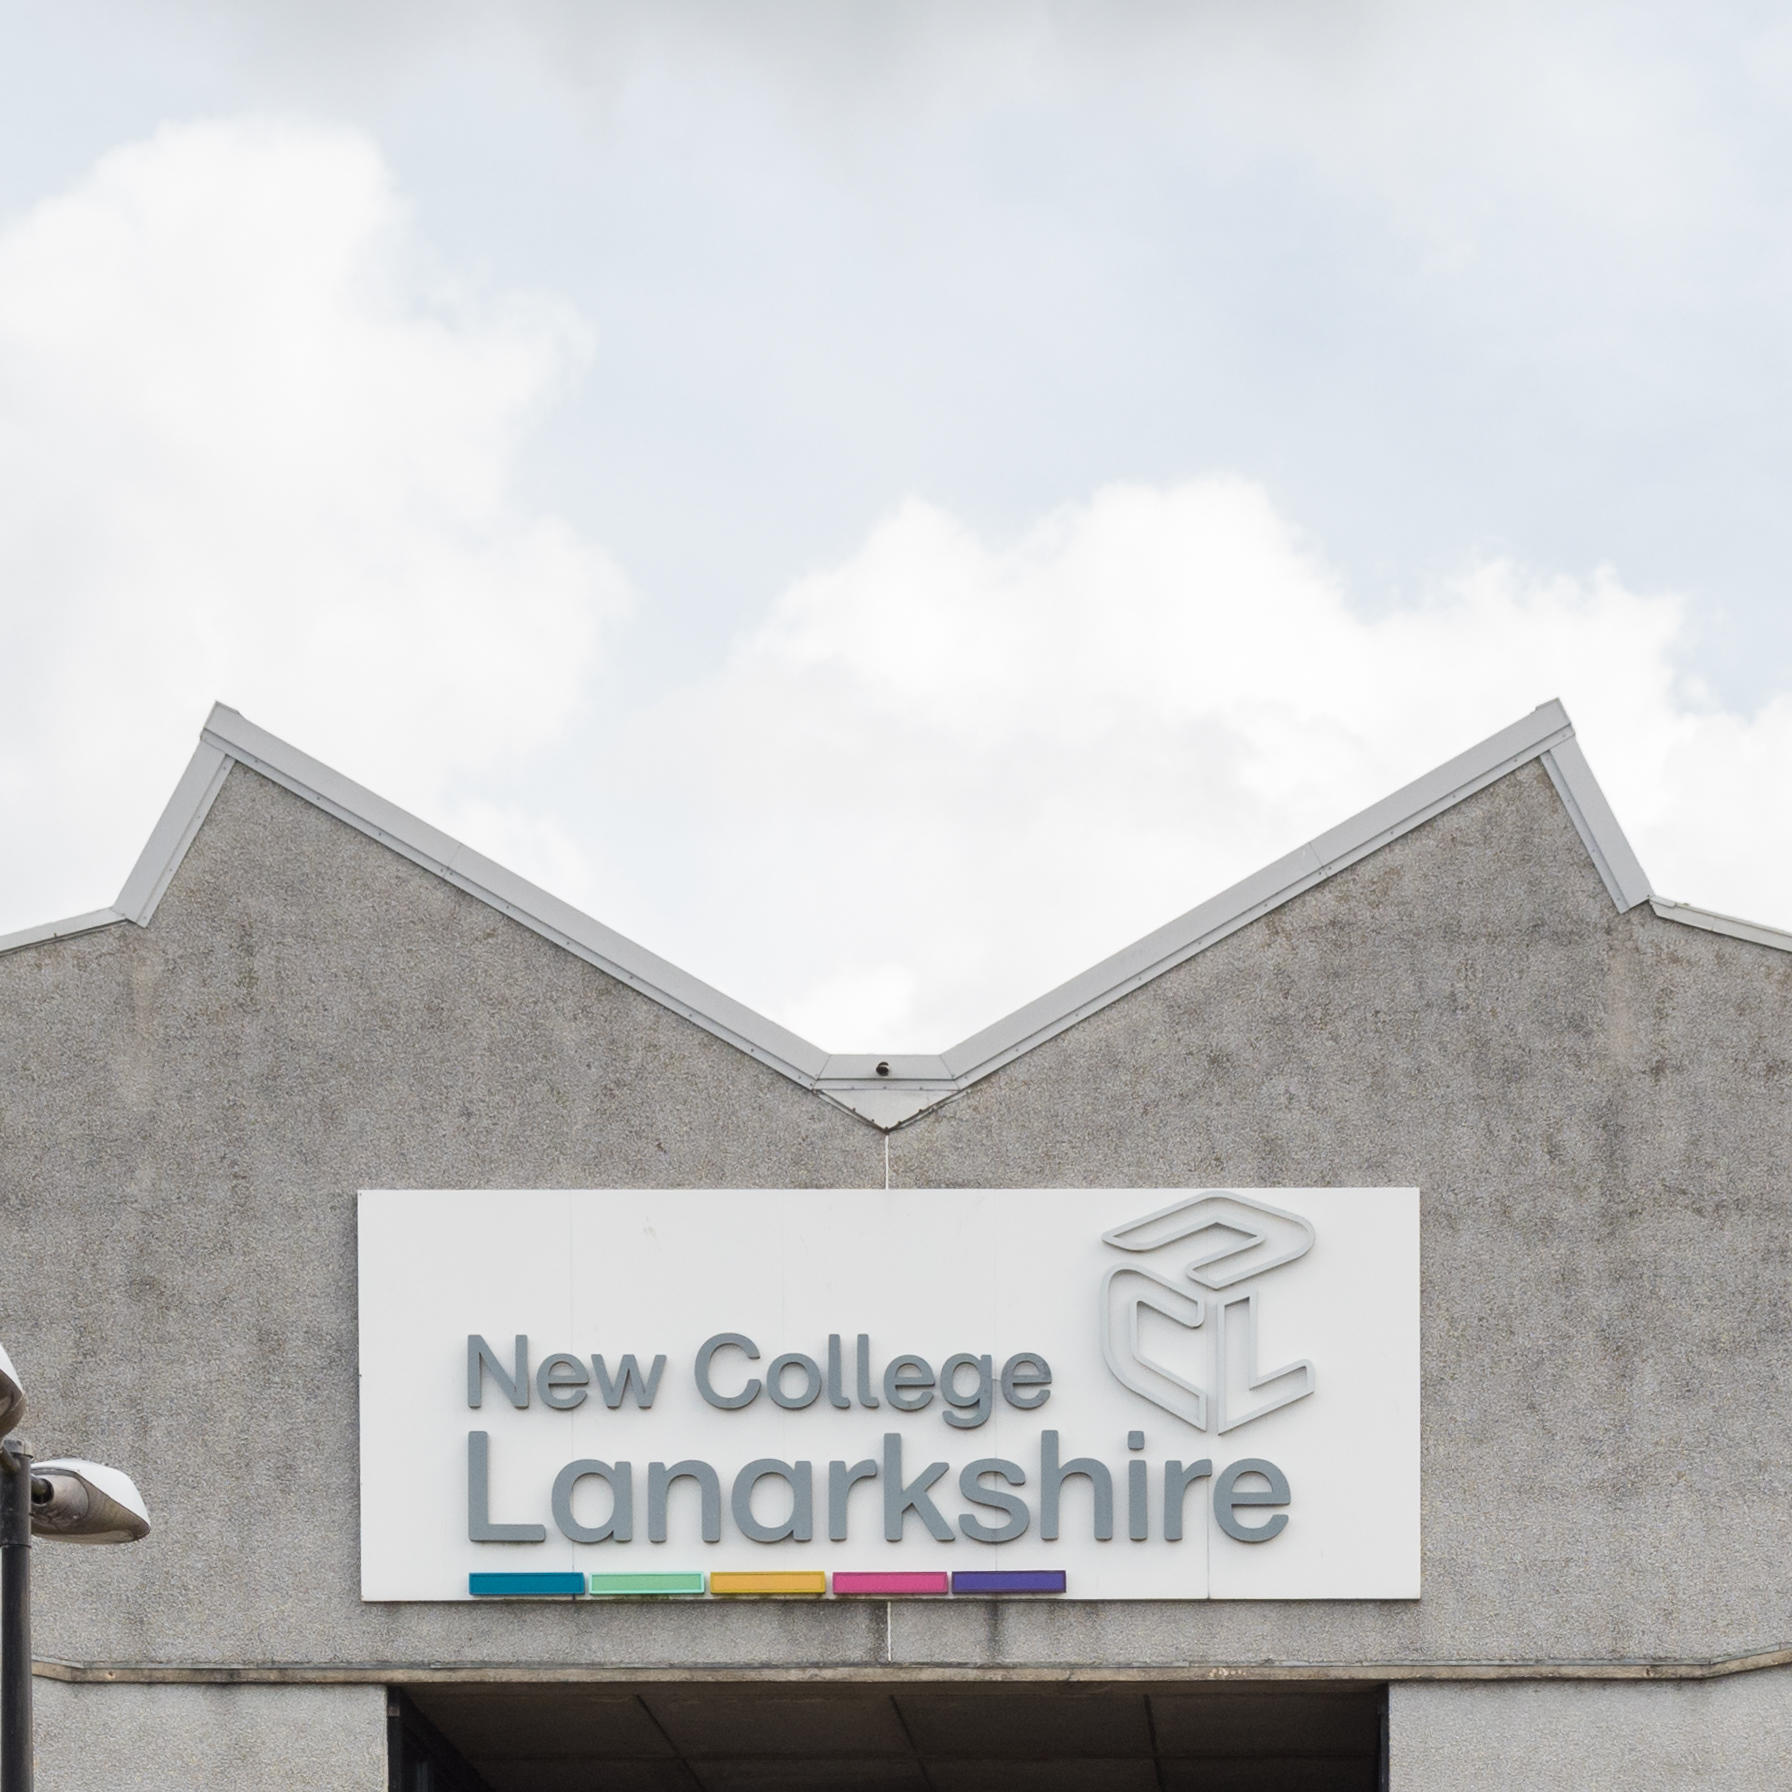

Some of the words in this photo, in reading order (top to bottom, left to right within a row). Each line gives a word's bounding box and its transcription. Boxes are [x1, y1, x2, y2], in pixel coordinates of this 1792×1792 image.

[466, 1333, 667, 1411] New
[694, 1332, 1053, 1430] College
[467, 1429, 1292, 1544] Lanarkshire
